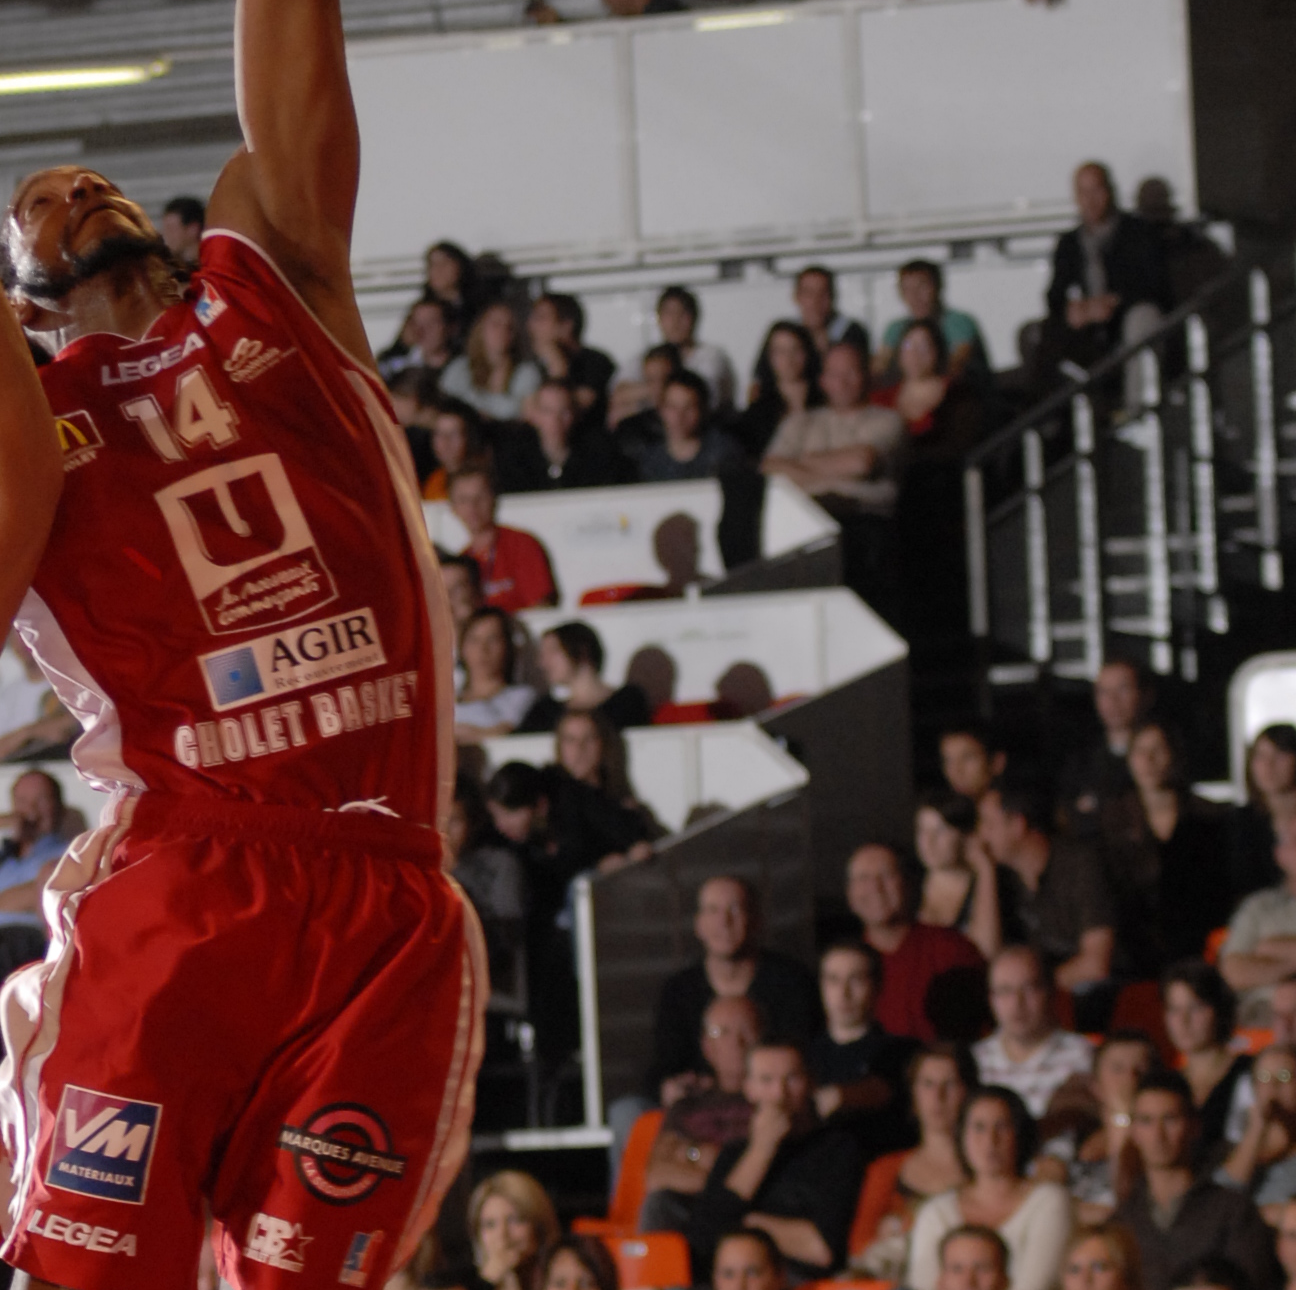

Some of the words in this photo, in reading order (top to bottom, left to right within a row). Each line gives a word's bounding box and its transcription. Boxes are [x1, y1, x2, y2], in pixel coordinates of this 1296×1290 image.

[102, 332, 205, 386] LEGEA
[119, 364, 240, 464] 14
[271, 615, 375, 673] AGIR
[175, 701, 307, 769] CHOLET
[66, 1107, 150, 1162] VM
[279, 1130, 351, 1161] MARQUES
[352, 1150, 406, 1175] AVENUE
[27, 1209, 137, 1257] LEGEA
